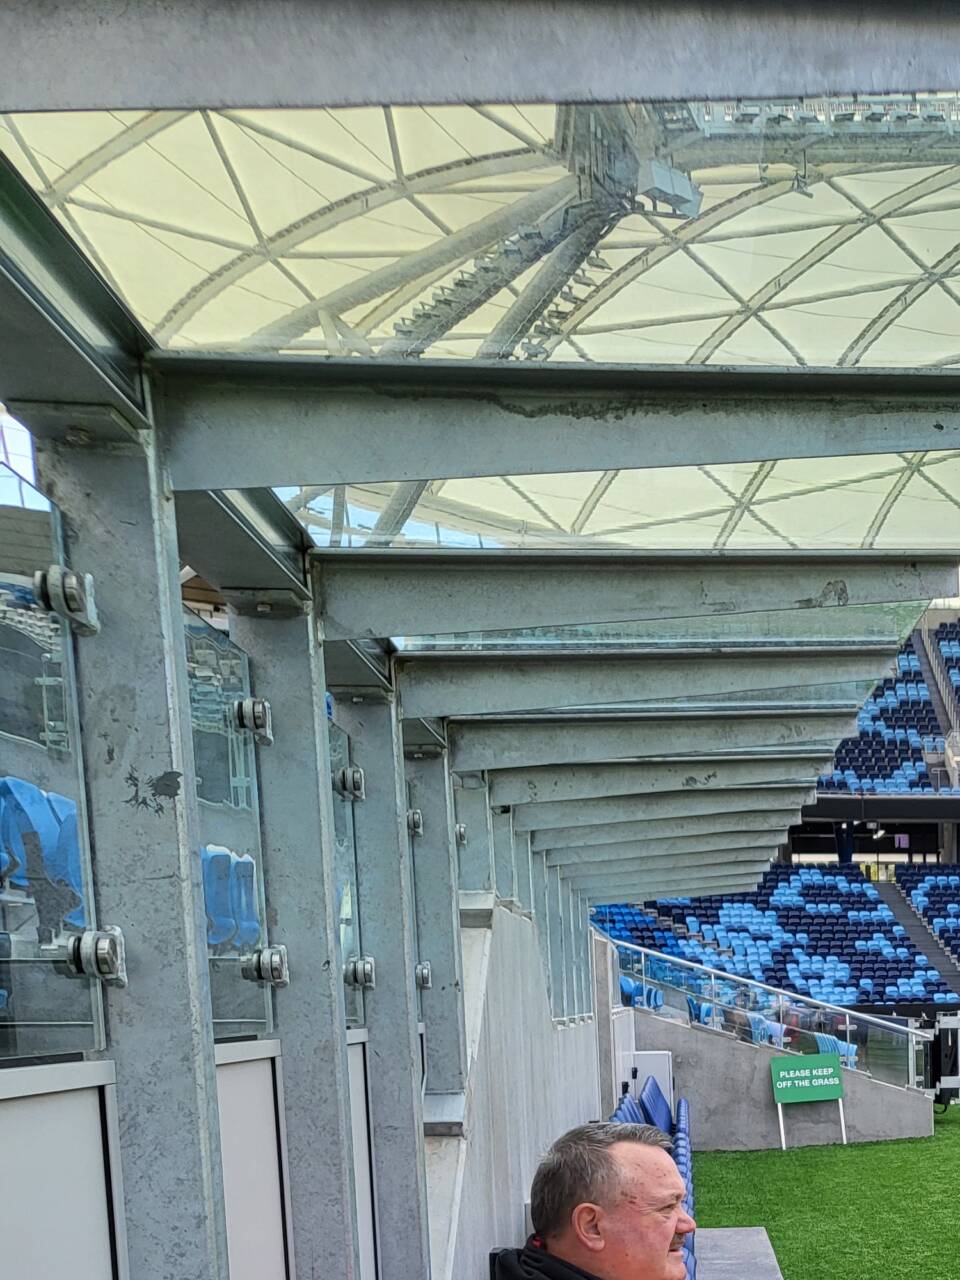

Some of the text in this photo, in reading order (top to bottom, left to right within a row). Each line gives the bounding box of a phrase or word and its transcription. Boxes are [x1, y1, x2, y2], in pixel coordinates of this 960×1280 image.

[779, 1067, 834, 1079] PLEASE KEEP
[776, 1077, 840, 1089] OFF THE GRASS
